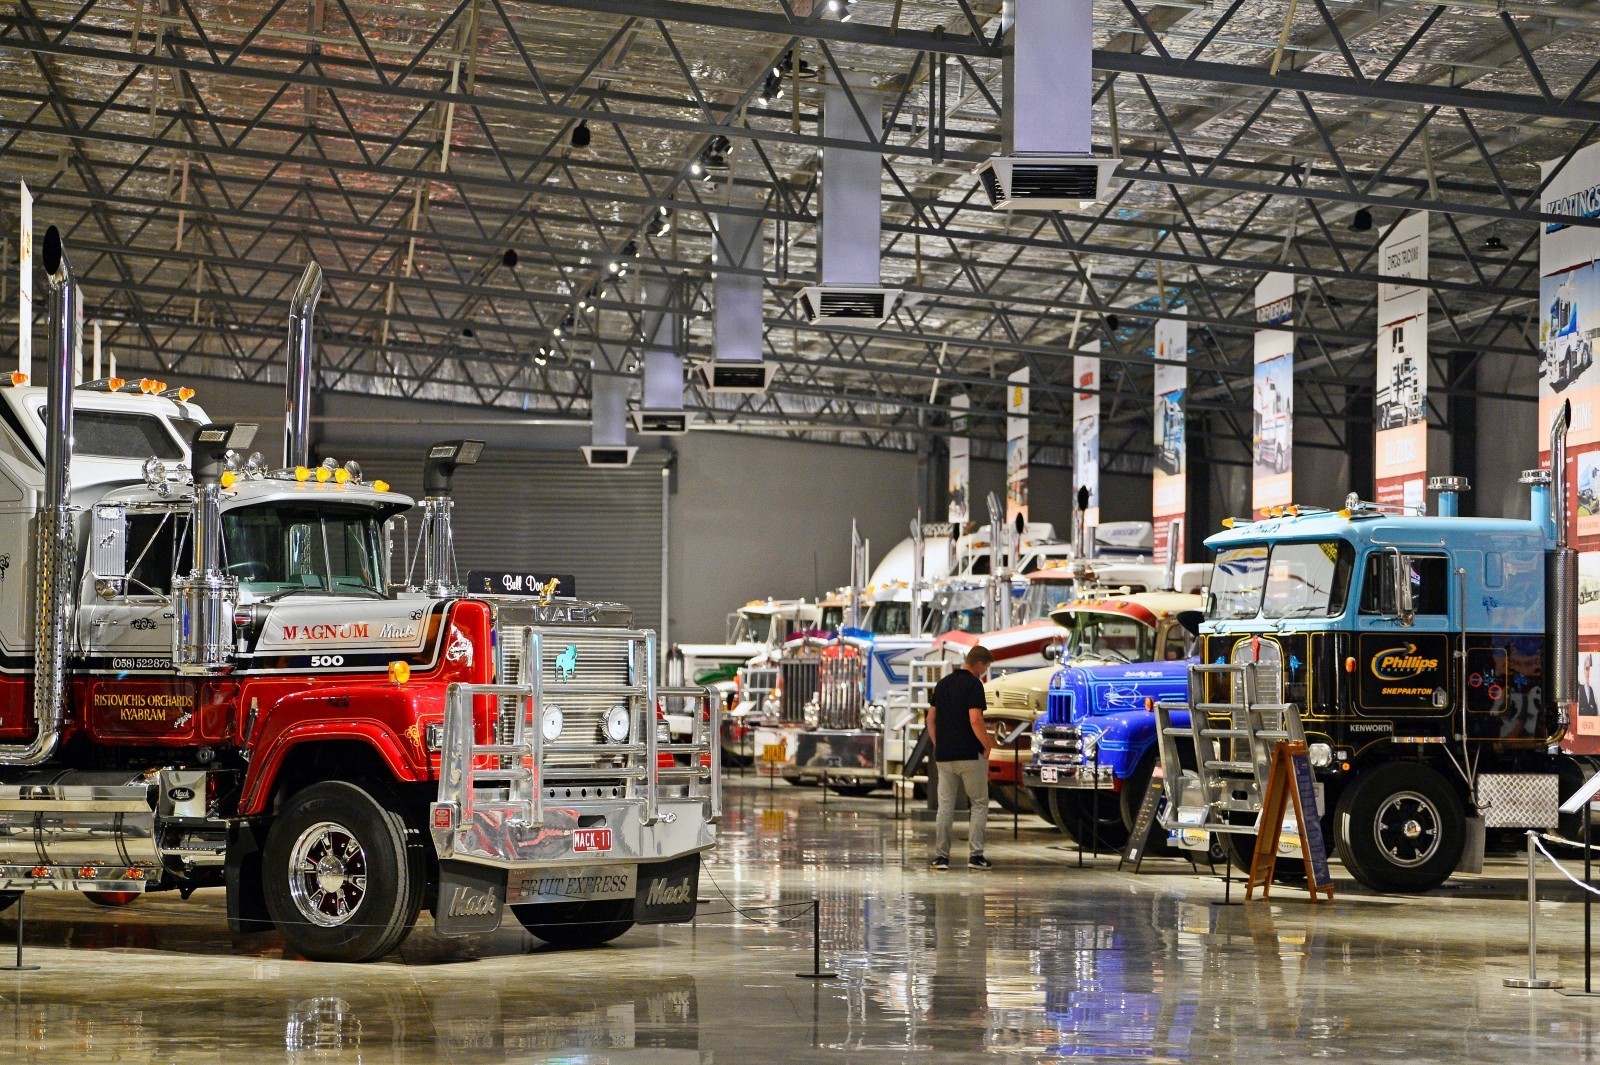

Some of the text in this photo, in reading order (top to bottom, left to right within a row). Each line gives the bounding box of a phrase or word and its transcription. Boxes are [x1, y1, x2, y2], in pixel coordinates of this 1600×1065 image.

[503, 574, 522, 591] Bull
[534, 606, 600, 622] MACK
[283, 624, 414, 640] MAGNUM Mack
[112, 657, 170, 669] (058) 522875
[311, 655, 344, 667] 500
[1381, 656, 1438, 673] Phillips
[1381, 687, 1433, 695] SHEPPARTON
[94, 694, 193, 707] RISTOVICHIS ORCHARDS
[120, 708, 166, 721] KYABRAM
[1349, 724, 1392, 732] KENWORTH
[172, 789, 190, 799] Mack
[519, 874, 628, 897] FRUIT EXPRESS
[646, 877, 691, 906] Mack
[448, 887, 497, 917] Mack
